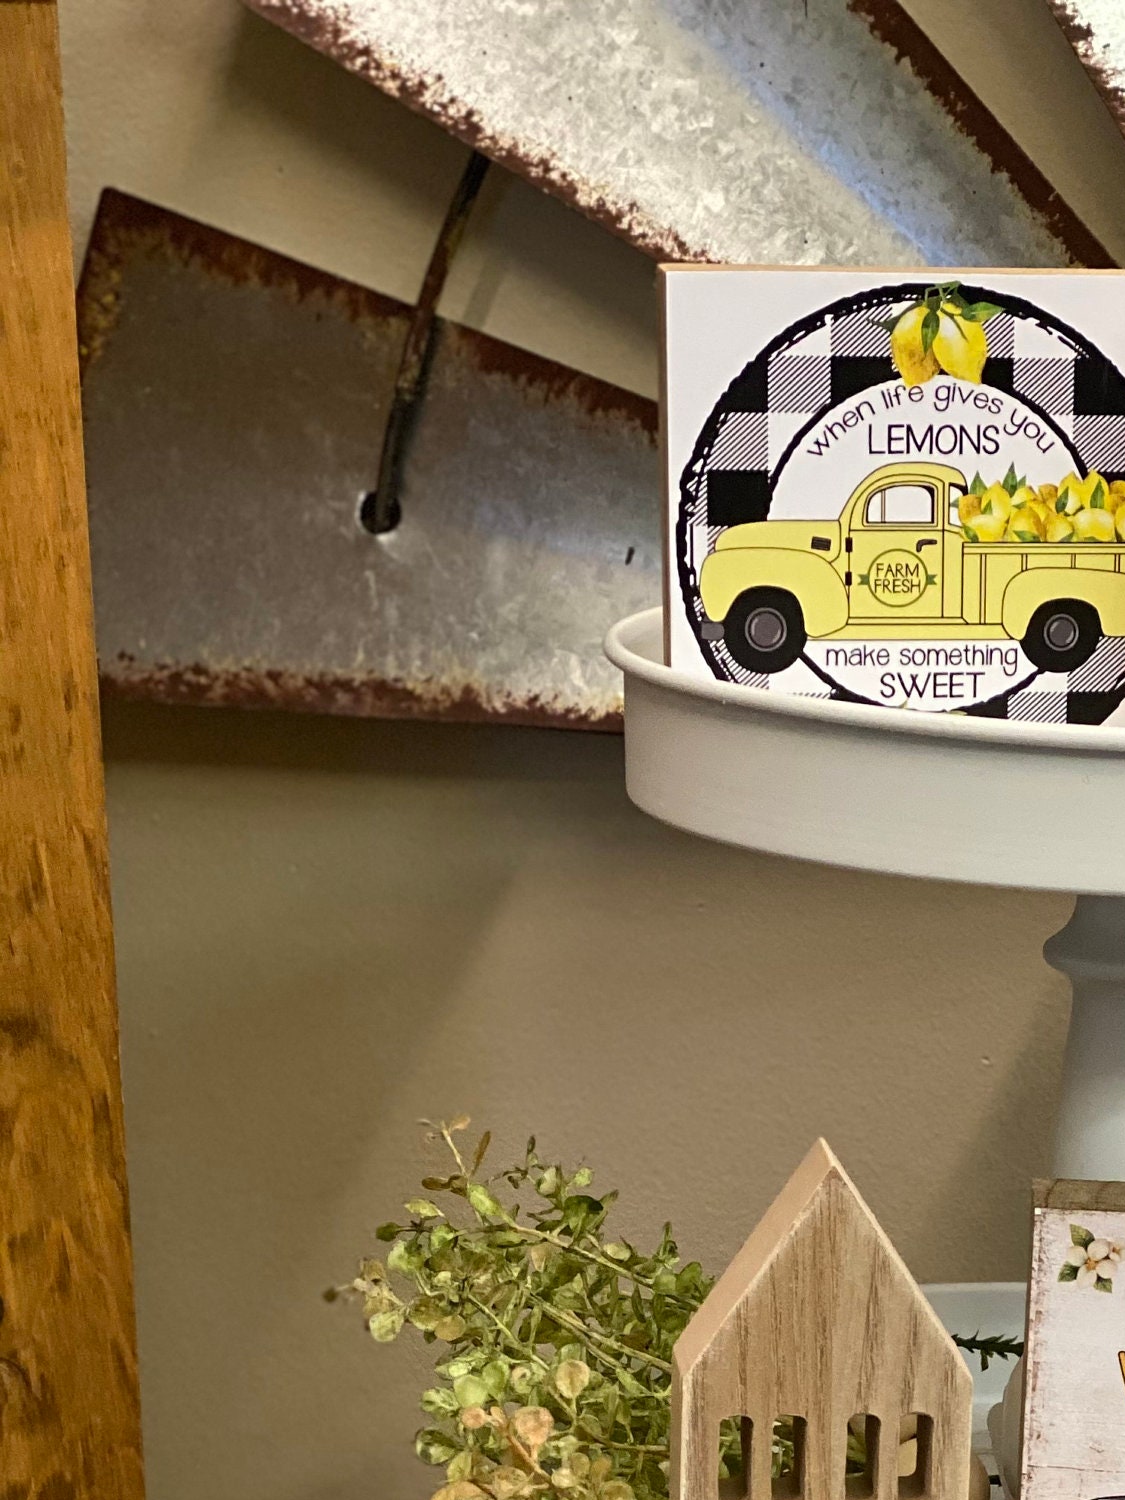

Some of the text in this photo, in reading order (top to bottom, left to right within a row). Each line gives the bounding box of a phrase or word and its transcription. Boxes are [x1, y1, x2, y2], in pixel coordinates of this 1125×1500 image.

[807, 382, 1056, 457] when life gives you
[868, 424, 1001, 455] LEMONS
[875, 562, 920, 579] FARM
[874, 578, 921, 594] FRESH
[825, 645, 1018, 676] make something
[880, 672, 986, 699] SWEET
